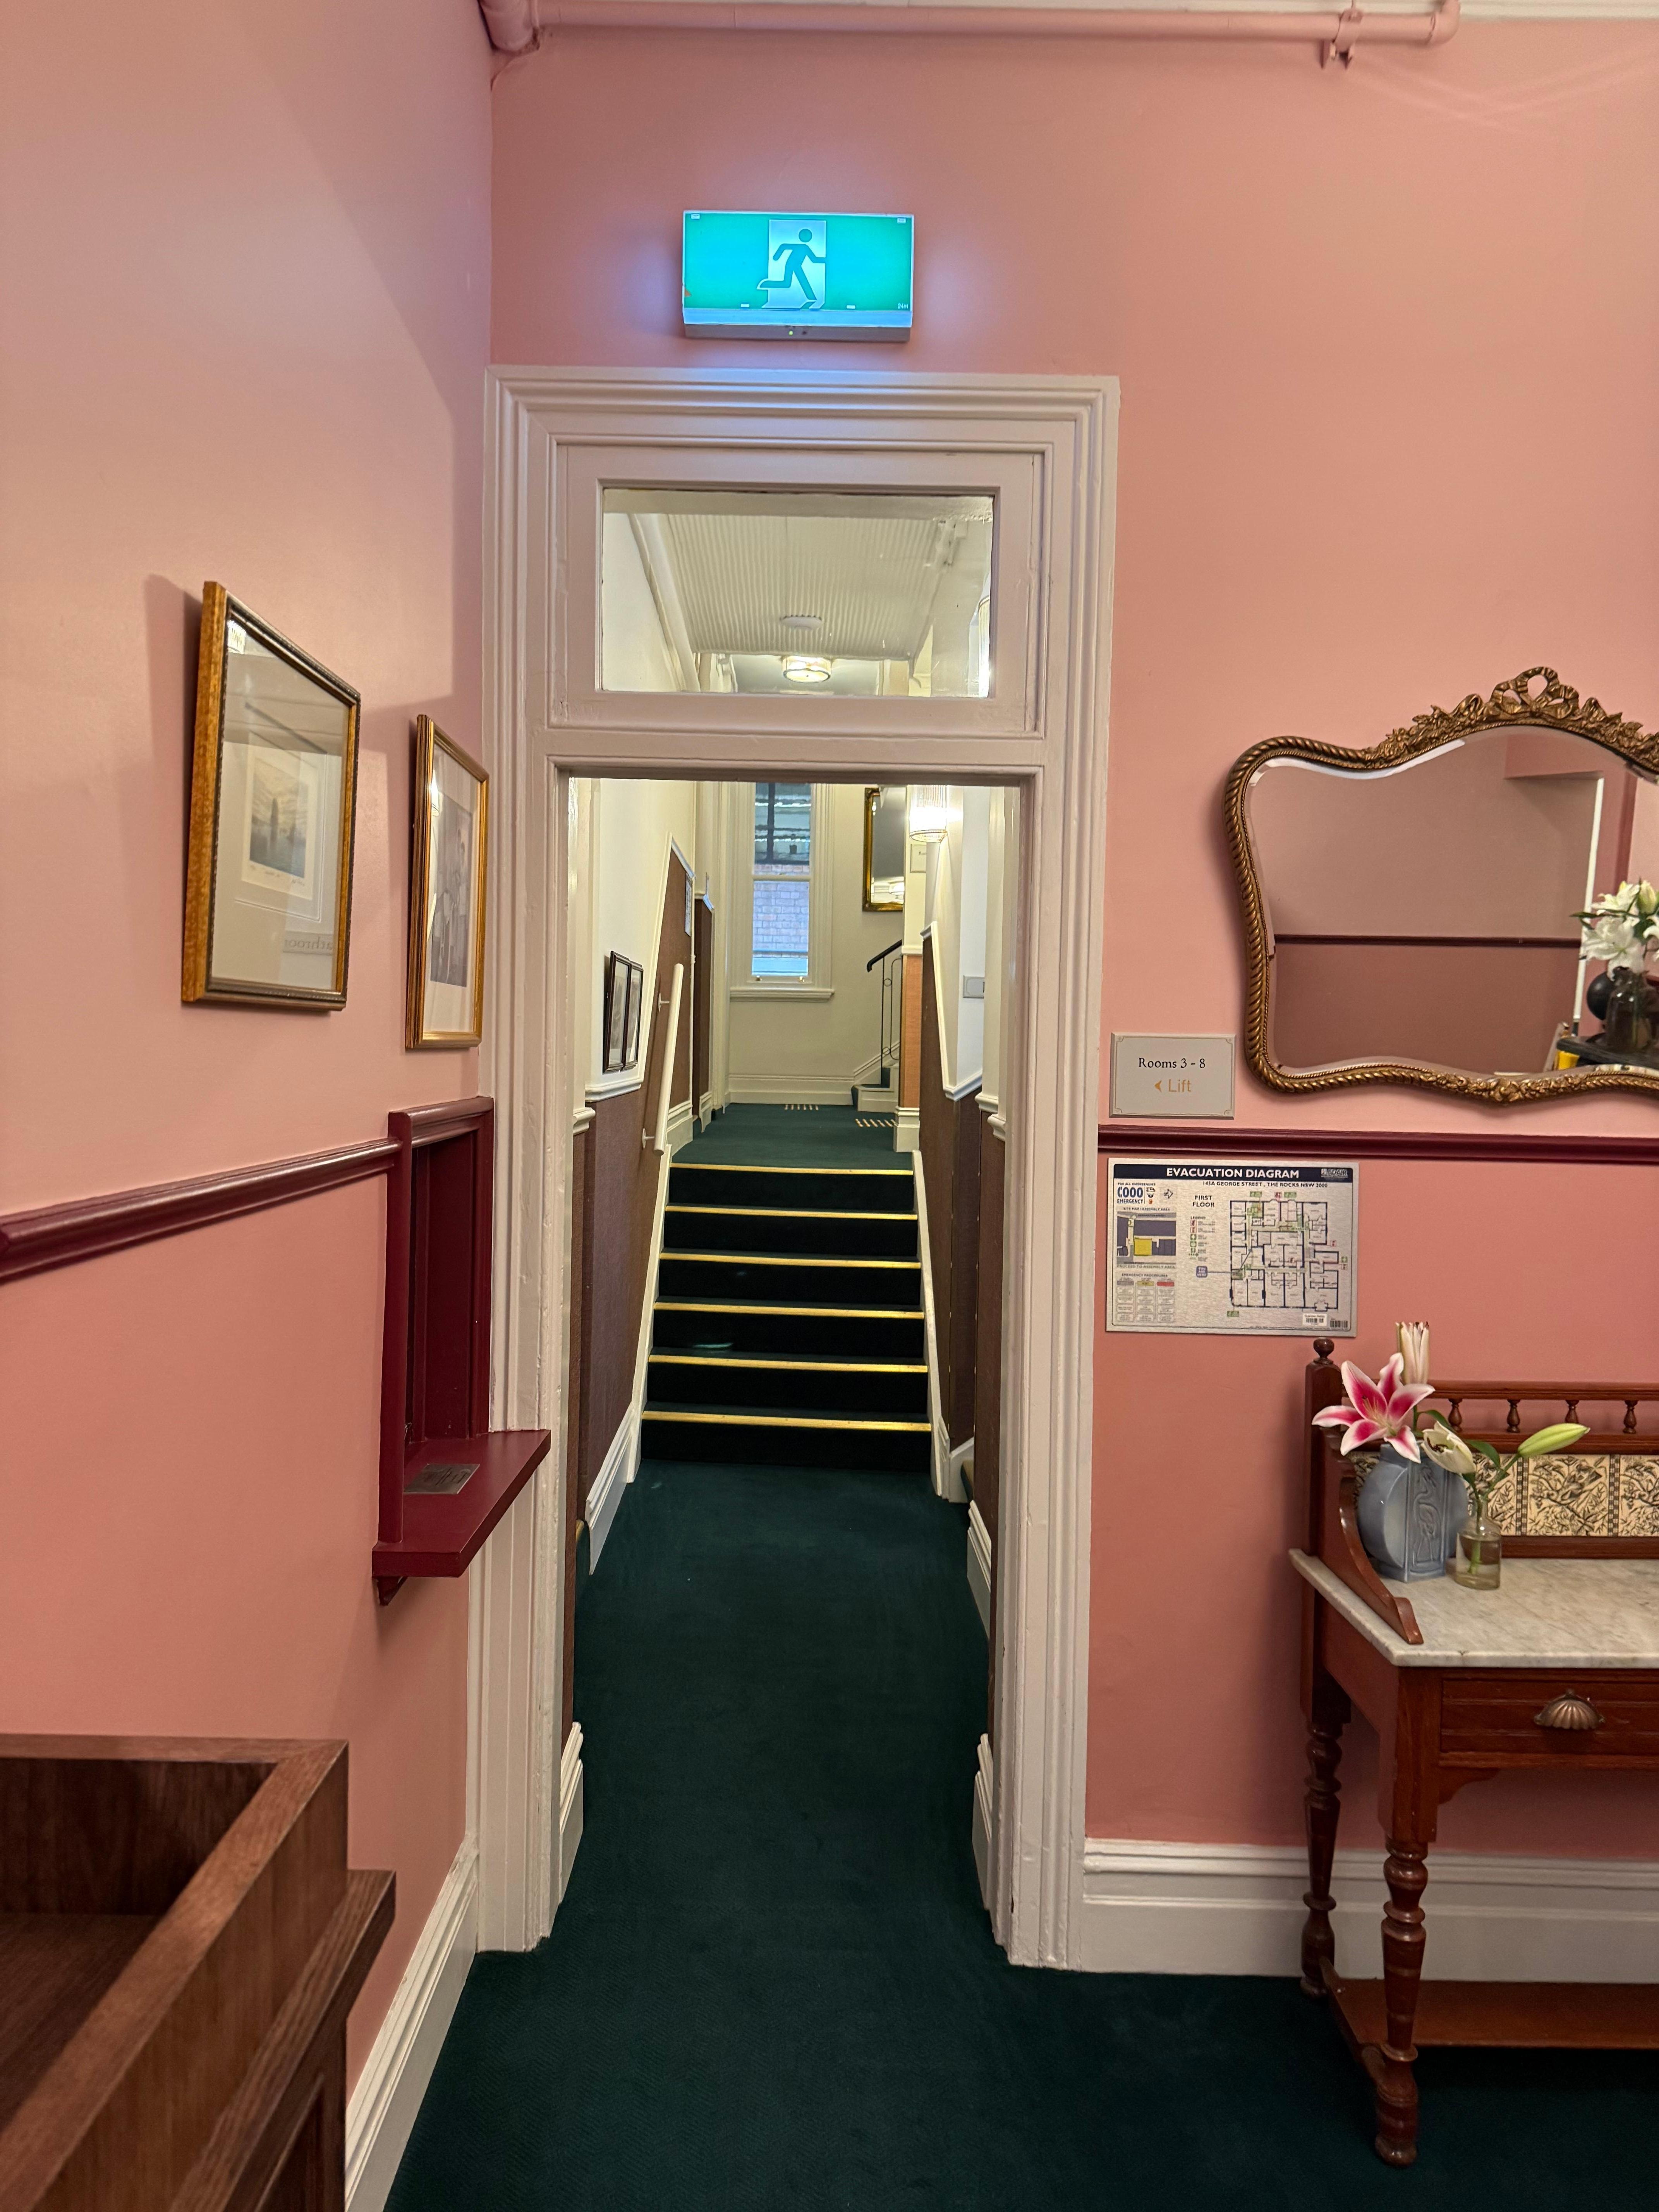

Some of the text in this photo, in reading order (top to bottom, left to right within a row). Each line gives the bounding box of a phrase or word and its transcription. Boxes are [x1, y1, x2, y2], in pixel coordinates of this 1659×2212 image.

[1139, 1058, 1177, 1068] Rooms
[1180, 1058, 1187, 1069] 3
[1199, 1058, 1206, 1069] 8
[1168, 1079, 1192, 1092] Lift
[1166, 1168, 1299, 1178] EVACUATION DIAGRAM
